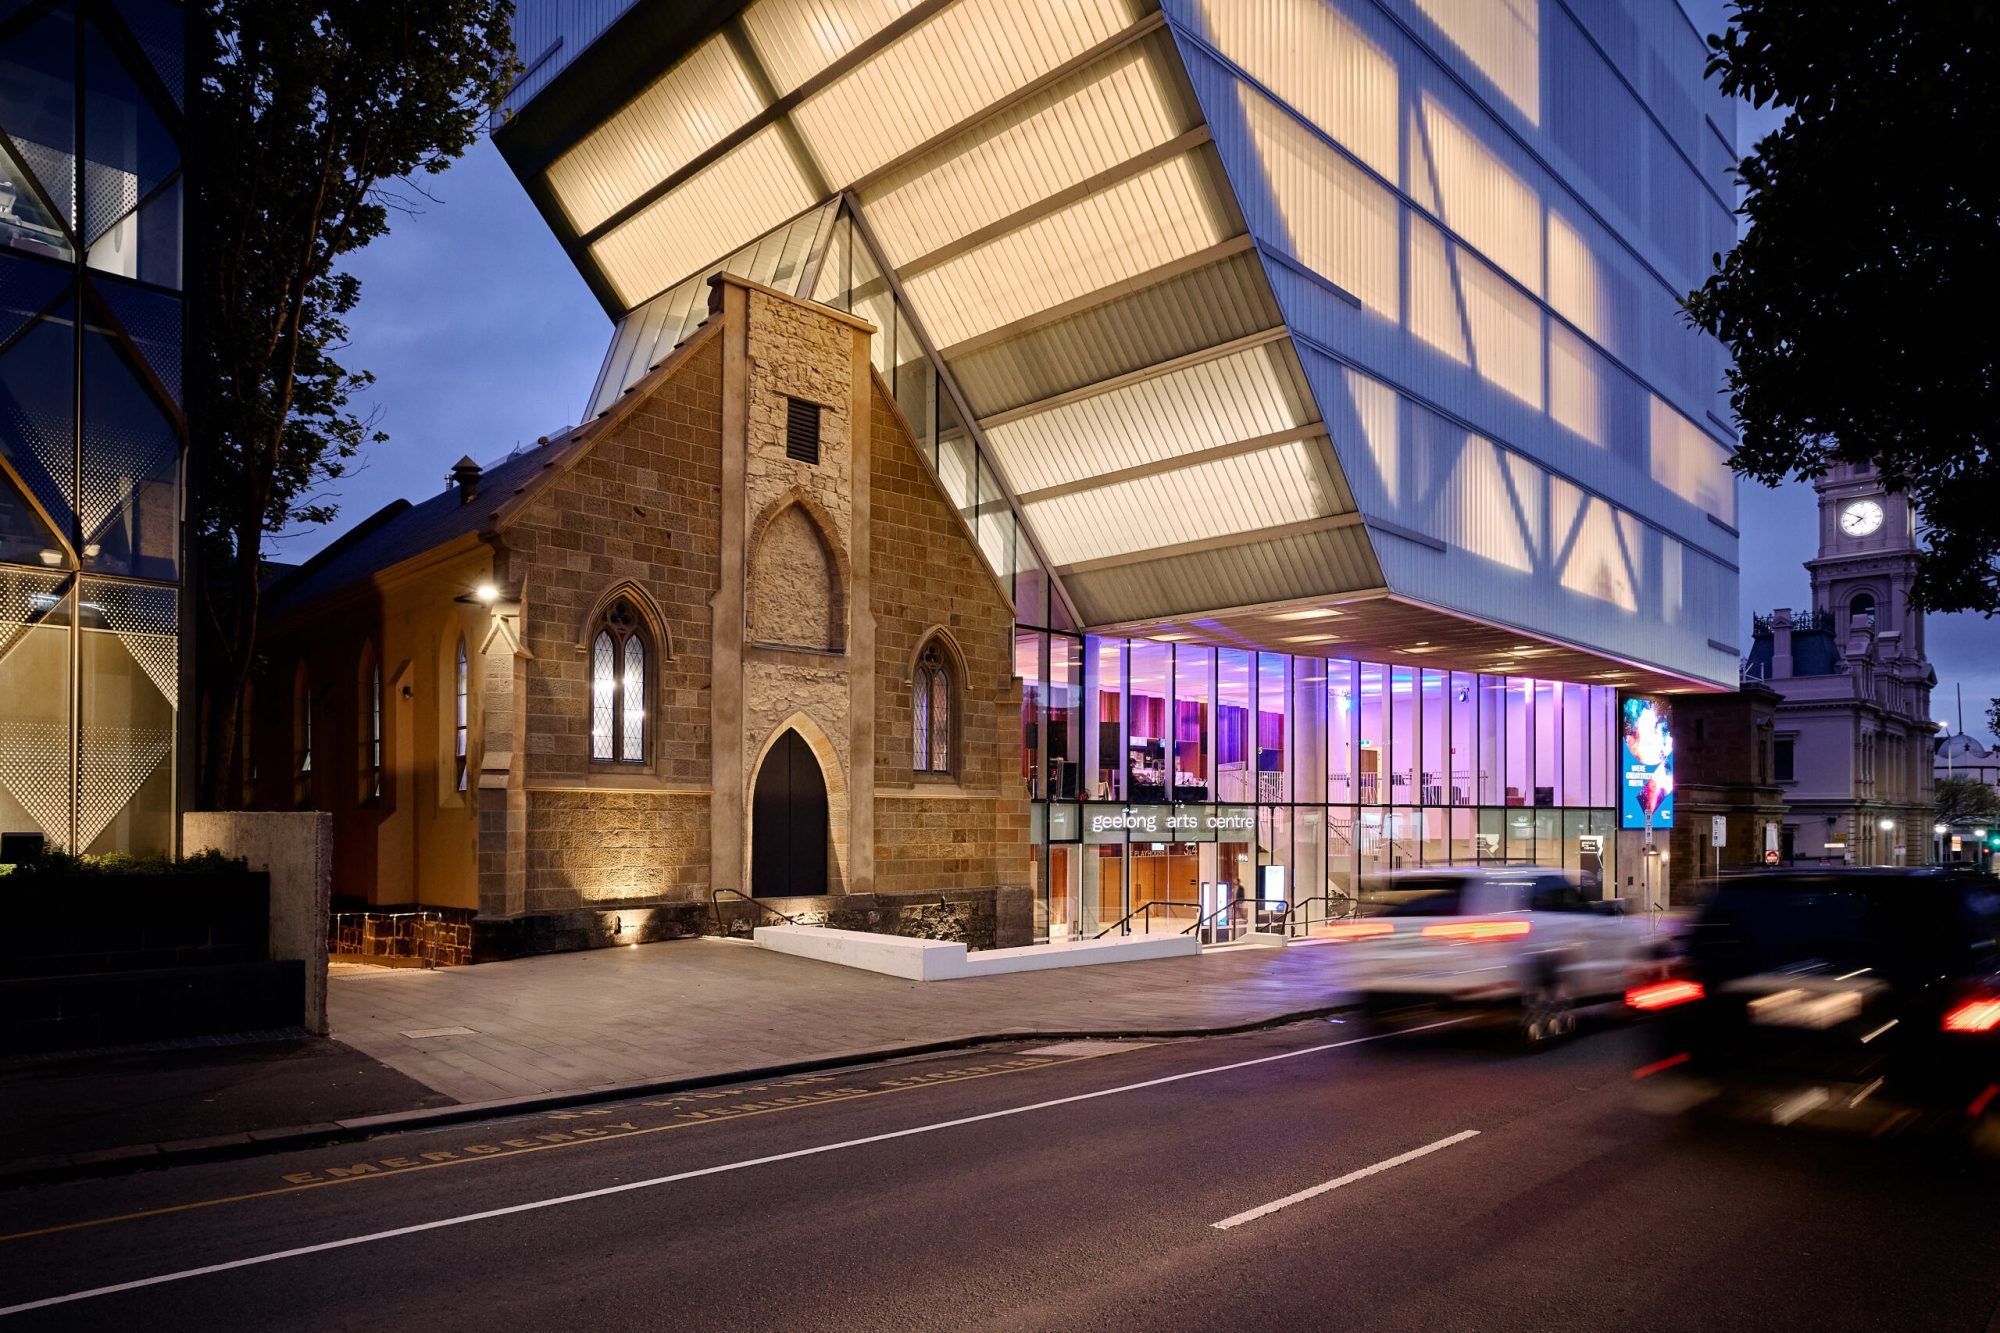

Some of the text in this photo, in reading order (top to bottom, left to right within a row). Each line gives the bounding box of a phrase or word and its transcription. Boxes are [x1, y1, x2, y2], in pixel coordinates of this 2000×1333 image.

[1092, 813, 1255, 832] geelong arts centre
[280, 1058, 1054, 1185] EMERGENCY VEHICLES EXCEPTED
